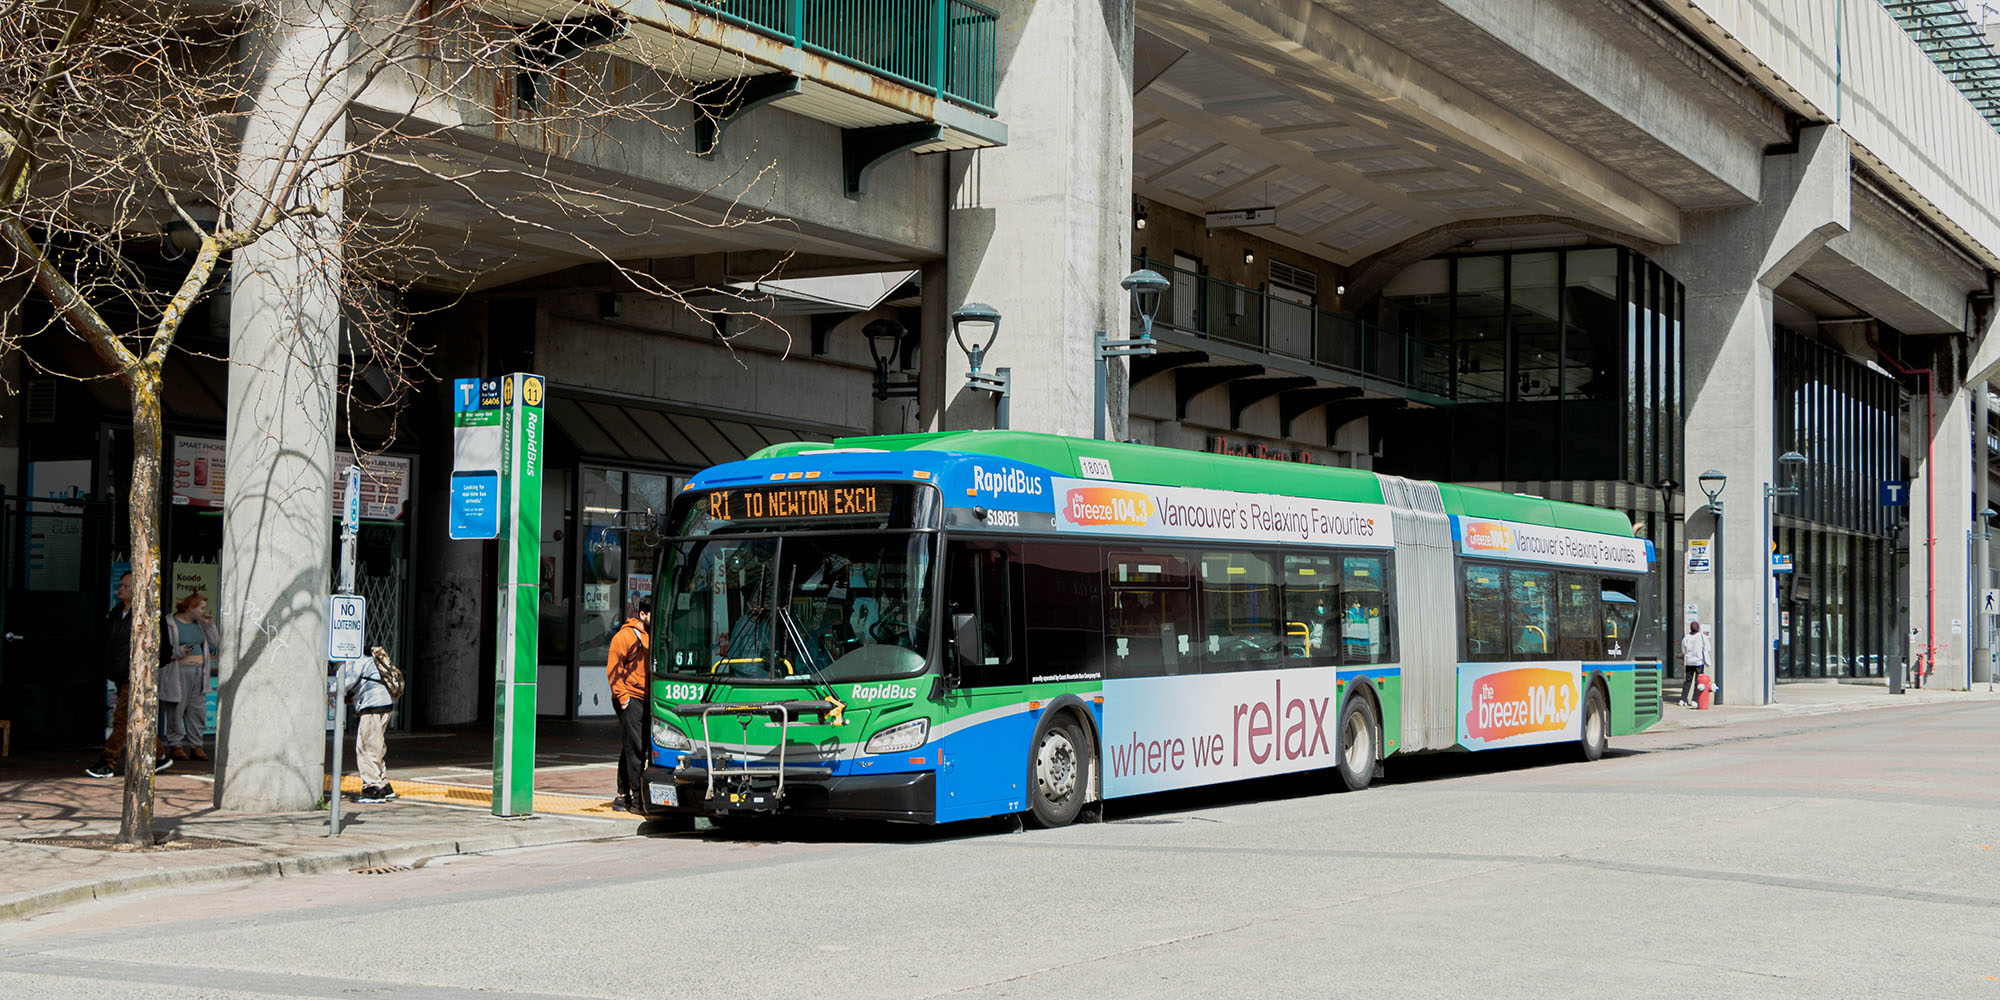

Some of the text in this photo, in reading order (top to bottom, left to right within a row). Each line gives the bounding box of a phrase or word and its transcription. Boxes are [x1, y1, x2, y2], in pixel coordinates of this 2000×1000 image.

[460, 384, 474, 406] T
[482, 397, 500, 406] 56406
[528, 388, 538, 402] 11
[526, 412, 538, 477] RapidBus
[1082, 461, 1110, 476] 18031
[974, 465, 1042, 498] RapidBus
[1074, 492, 1084, 502] the
[1887, 485, 1902, 502] T
[710, 487, 876, 521] R1 TO NEWTON EXCH
[1072, 498, 1148, 522] breeze 104.3
[987, 509, 1019, 527] S18031
[1156, 496, 1374, 540] Vancouver's Relaxing Favourites
[1513, 529, 1636, 564] Vancouver's Relaxing Favourites
[176, 573, 201, 581] Koodo
[176, 583, 208, 592] Prepid.
[341, 604, 355, 616] NO
[334, 619, 361, 630] LOITERING
[665, 684, 917, 702] 18031 RapidBus
[1482, 683, 1494, 699] the
[1479, 684, 1570, 729] breeze 104.3
[1111, 679, 1330, 778] where we relax
